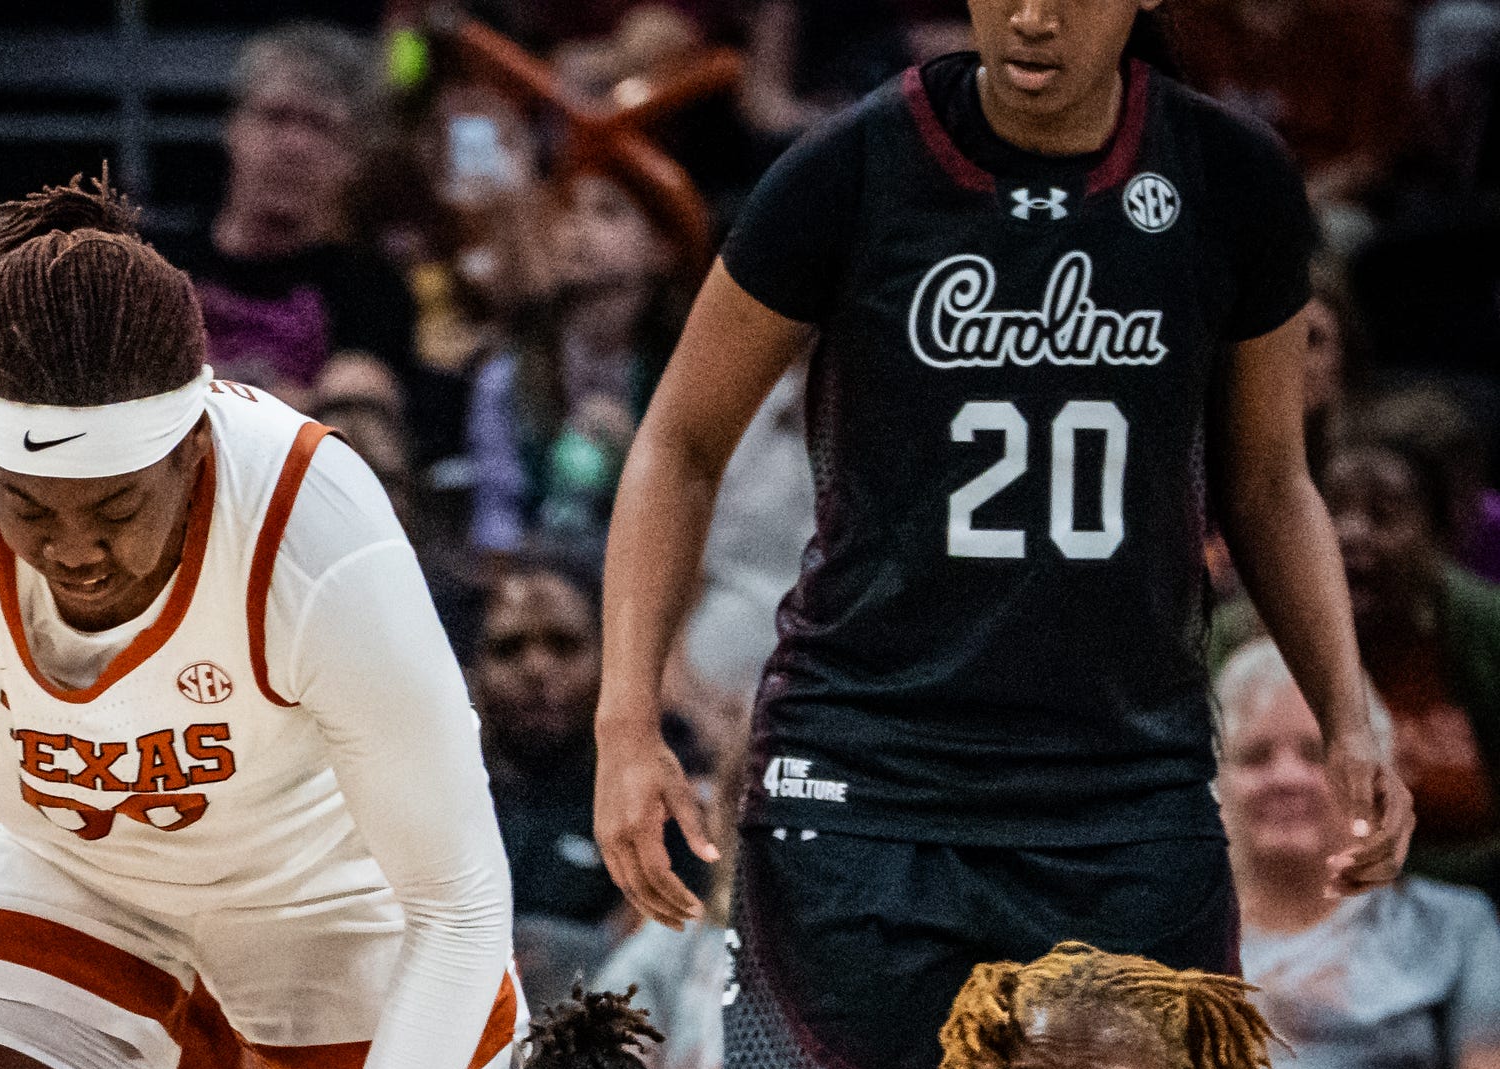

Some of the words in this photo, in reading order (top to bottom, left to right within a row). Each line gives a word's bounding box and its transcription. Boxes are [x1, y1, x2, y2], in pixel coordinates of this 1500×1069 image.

[1126, 175, 1178, 231] SEC
[909, 250, 1169, 368] Carolina
[947, 401, 1129, 560] 20
[177, 662, 234, 704] SEC
[10, 722, 237, 793] EXAS
[763, 757, 781, 798] 4
[782, 759, 812, 778] THE
[780, 778, 848, 803] CULTURE
